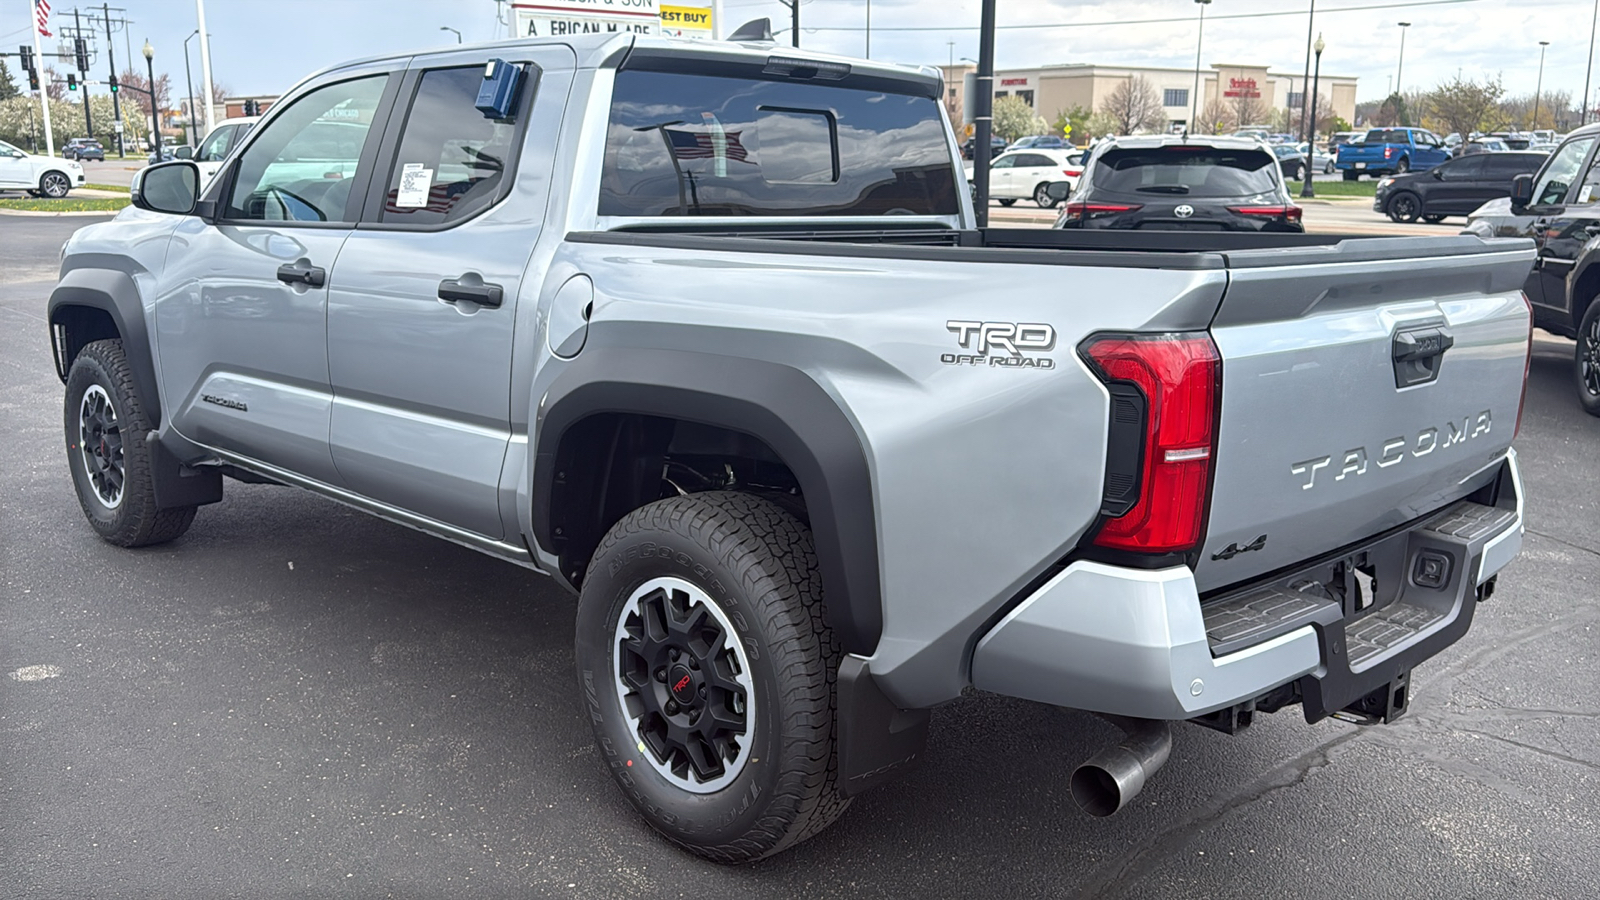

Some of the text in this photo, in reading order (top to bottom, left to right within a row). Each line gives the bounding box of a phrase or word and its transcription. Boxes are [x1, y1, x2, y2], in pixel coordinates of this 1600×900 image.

[660, 11, 708, 23] EST BUY
[946, 320, 1057, 358] TRD
[940, 353, 1056, 370] OFF ROAD
[1291, 409, 1493, 490] TACOMA
[673, 674, 691, 693] TRD
